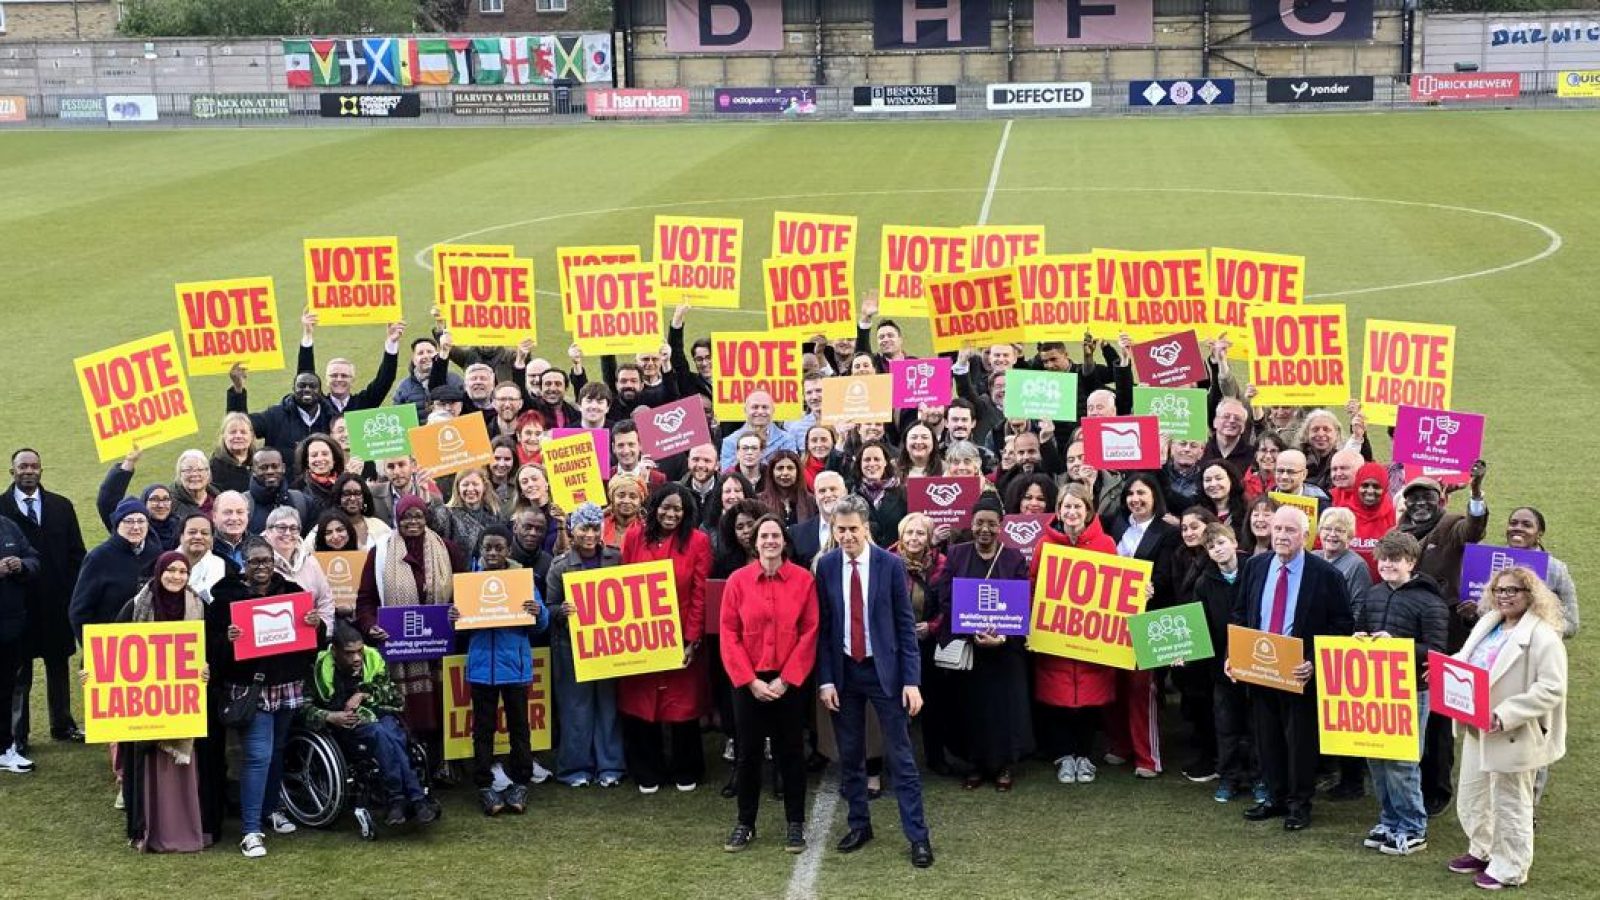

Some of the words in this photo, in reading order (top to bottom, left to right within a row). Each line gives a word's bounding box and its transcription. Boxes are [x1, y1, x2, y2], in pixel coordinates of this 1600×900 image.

[698, 0, 753, 46] D
[901, 0, 962, 43] H
[1279, 0, 1345, 36] C
[456, 93, 495, 103] HARVEY
[496, 92, 504, 102] &
[505, 92, 550, 102] WHEELER
[886, 87, 932, 97] BESPOKE
[1007, 88, 1084, 104] DEFECTED
[1311, 83, 1350, 97] yonder
[1438, 80, 1465, 89] BRICK
[1466, 78, 1513, 88] BREWERY
[217, 98, 239, 108] KICK
[240, 98, 255, 108] ON
[256, 98, 268, 107] AT
[268, 98, 289, 107] THE
[886, 97, 934, 106] WINDOWS
[659, 225, 738, 263] VOTE
[887, 234, 967, 274] VOTE
[311, 246, 395, 283] VOTE
[658, 264, 736, 290] LABOUR
[1120, 258, 1205, 298] VOTE
[312, 283, 398, 310] LABOUR
[449, 266, 529, 303] VOTE
[575, 271, 657, 312] VOTE
[768, 261, 849, 303] VOTE
[929, 274, 1014, 315] VOTE
[1018, 262, 1092, 300] VOTE
[1215, 257, 1298, 305] VOTE
[182, 286, 273, 330] VOTE
[450, 303, 532, 330] LABOUR
[771, 298, 852, 329] LABOUR
[934, 307, 1020, 338] LABOUR
[1124, 299, 1208, 326] LABOUR
[577, 310, 659, 340] LABOUR
[1252, 314, 1342, 358] VOTE
[188, 326, 278, 359] LABOUR
[1369, 329, 1449, 380] VOTE
[716, 340, 798, 377] VOTE
[1254, 357, 1344, 387] LABOUR
[83, 343, 179, 409] VOTE
[1365, 375, 1447, 411] LABOUR
[94, 387, 189, 441] LABOUR
[546, 441, 593, 461] TOGETHER
[1105, 450, 1135, 459] Labour
[1412, 453, 1440, 462] culture
[1439, 456, 1460, 465] pass
[1432, 445, 1449, 454] free
[553, 457, 593, 475] AGAINST
[564, 472, 588, 487] HATE
[929, 508, 954, 516] council
[954, 509, 967, 518] you
[571, 571, 666, 626] VOTE
[1045, 554, 1145, 614] VOTE
[959, 613, 989, 622] Building
[990, 614, 1024, 622] genuinely
[998, 622, 1022, 630] homes
[257, 632, 290, 644] Labour
[385, 640, 413, 648] Building
[414, 639, 449, 648] genuinely
[386, 647, 422, 655] affordable
[576, 619, 678, 660] LABOUR
[1173, 641, 1193, 651] youth
[91, 633, 199, 684] VOTE
[1156, 649, 1193, 662] guarantee
[1320, 647, 1411, 700] VOTE
[92, 683, 201, 719] LABOUR
[1323, 699, 1414, 737] LABOUR
